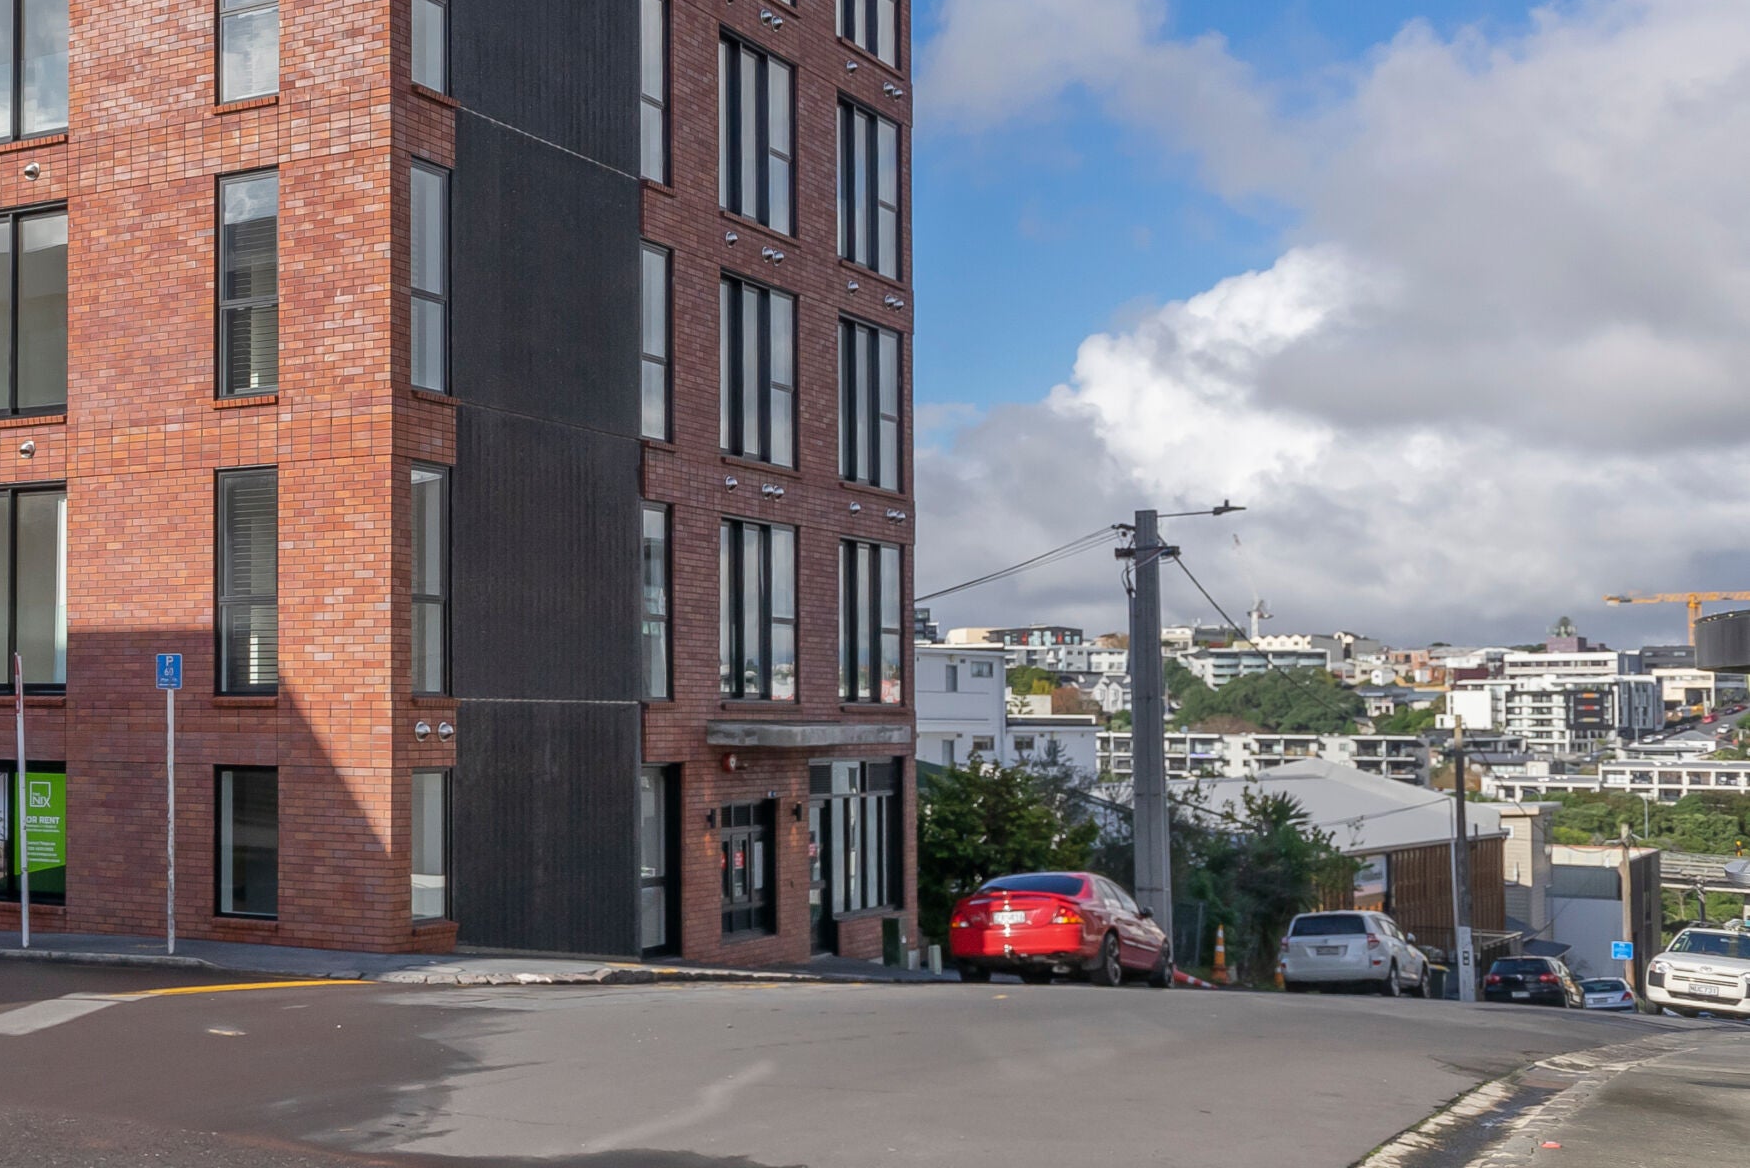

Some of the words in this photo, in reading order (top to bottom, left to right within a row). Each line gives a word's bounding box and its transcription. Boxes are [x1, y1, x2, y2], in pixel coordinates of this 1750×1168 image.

[166, 656, 174, 666] P
[32, 796, 51, 808] NIX
[39, 816, 60, 824] RENT
